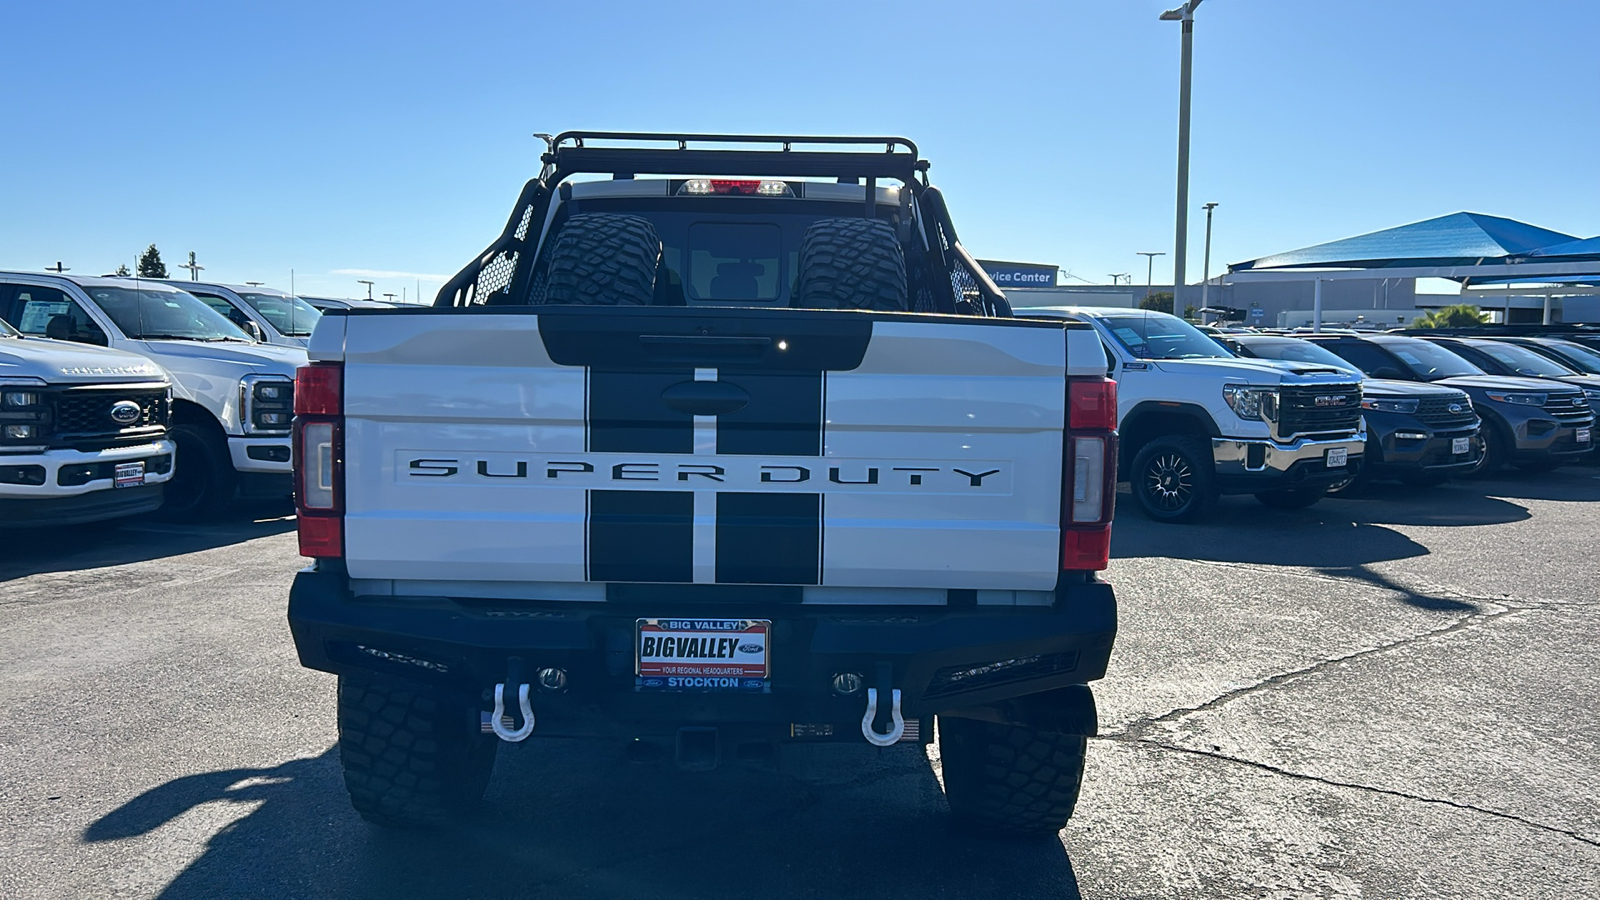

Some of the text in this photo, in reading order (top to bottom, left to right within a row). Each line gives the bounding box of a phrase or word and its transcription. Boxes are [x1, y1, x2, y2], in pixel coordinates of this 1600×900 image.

[989, 271, 1050, 283] vice Center
[1315, 395, 1347, 407] GMC
[409, 458, 1001, 488] SUPER DUTY
[670, 621, 739, 630] BIG VALLEY
[741, 645, 761, 653] Ford
[662, 666, 744, 675] YOUR REGIONAL HEADQUARTERS
[668, 677, 739, 688] STOCKTON
